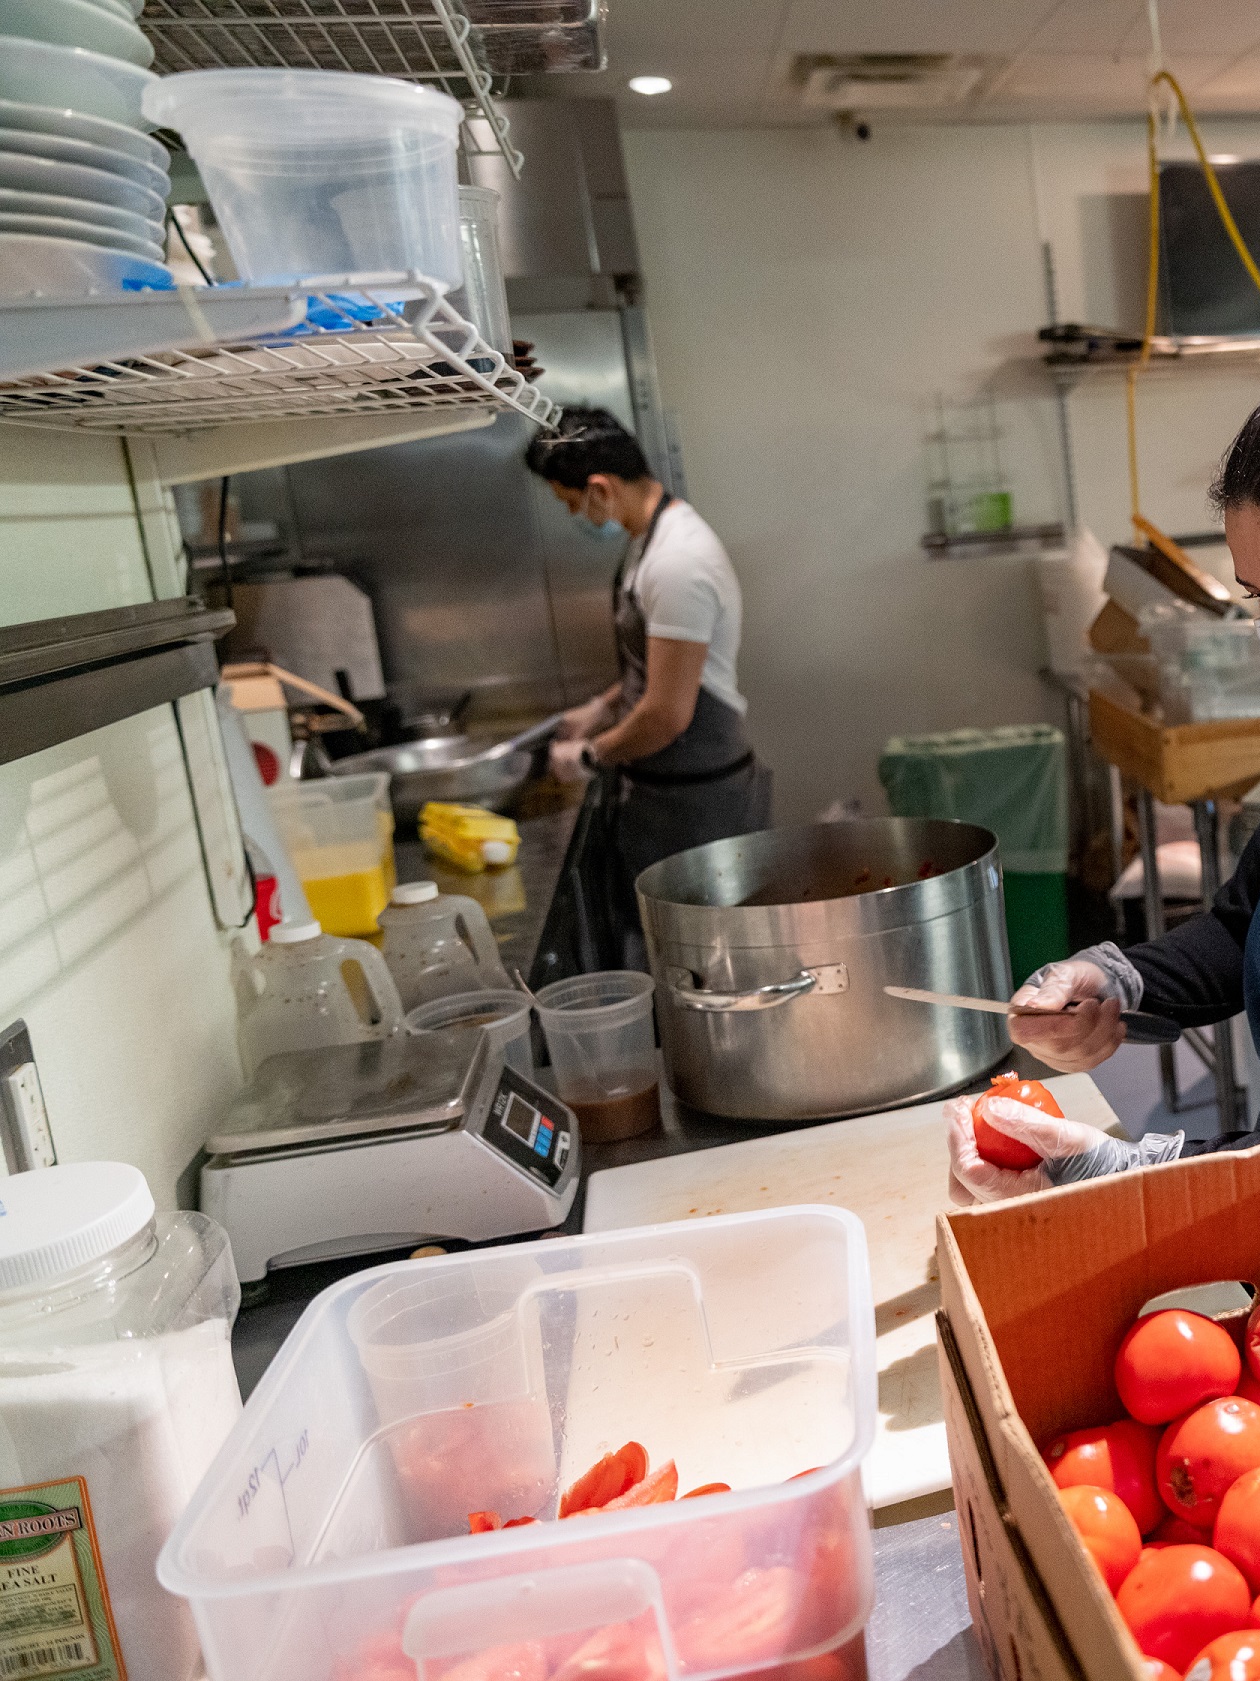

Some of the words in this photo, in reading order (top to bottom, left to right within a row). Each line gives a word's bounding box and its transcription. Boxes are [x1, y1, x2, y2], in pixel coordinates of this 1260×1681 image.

[18, 1513, 77, 1535] ROOTS
[7, 1565, 39, 1579] FINE
[0, 1581, 21, 1592] EA
[24, 1573, 57, 1588] SALT
